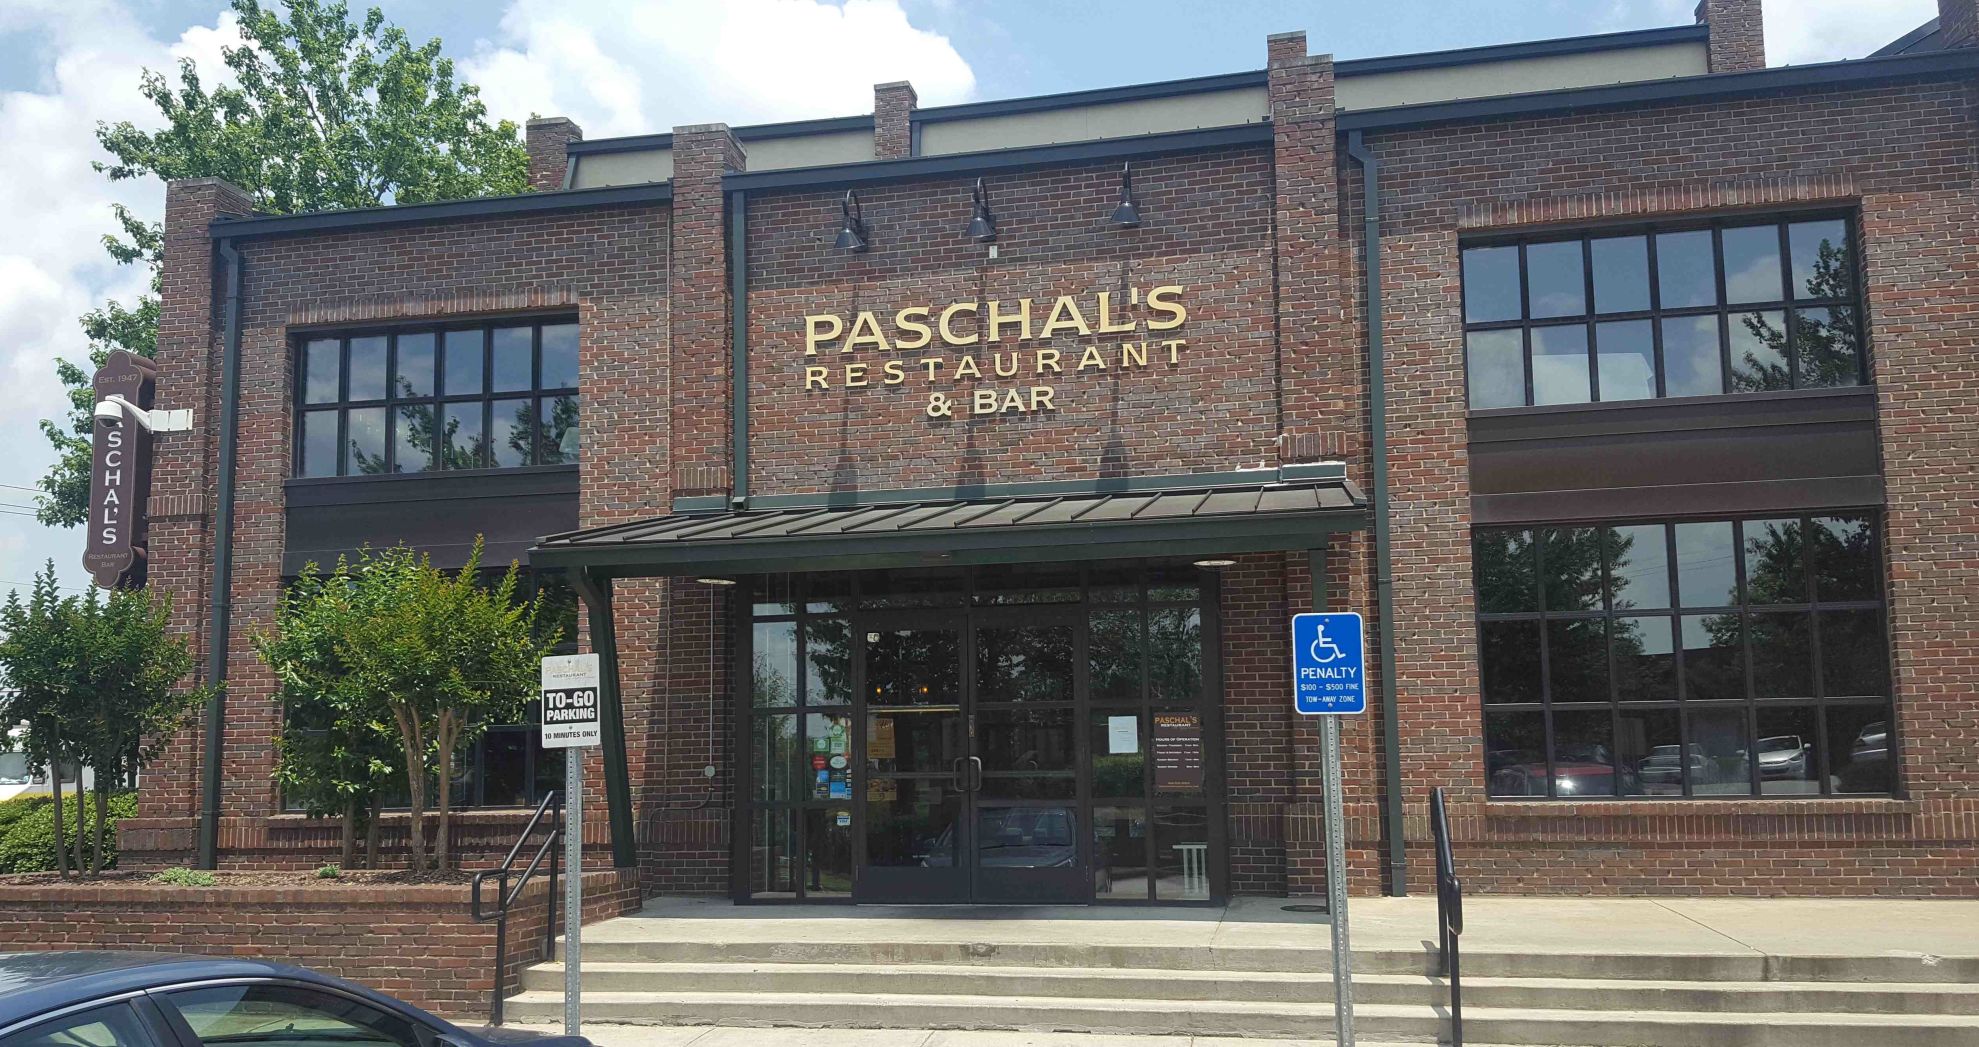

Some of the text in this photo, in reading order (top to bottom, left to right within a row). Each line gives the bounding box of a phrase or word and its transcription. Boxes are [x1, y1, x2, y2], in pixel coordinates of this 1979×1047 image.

[804, 285, 1187, 355] PASCHAL'S
[805, 339, 1187, 390] RESTAURANT
[118, 373, 138, 383] 1947
[927, 386, 1056, 418] & BAR
[102, 420, 124, 545] SCHAL'S
[1301, 667, 1357, 679] PENALTY
[1301, 683, 1317, 691] $100
[1325, 683, 1344, 691] $500
[546, 690, 594, 708] TO-GO
[546, 707, 595, 722] PARKING
[545, 730, 598, 740] 10 MINUTES ONLY
